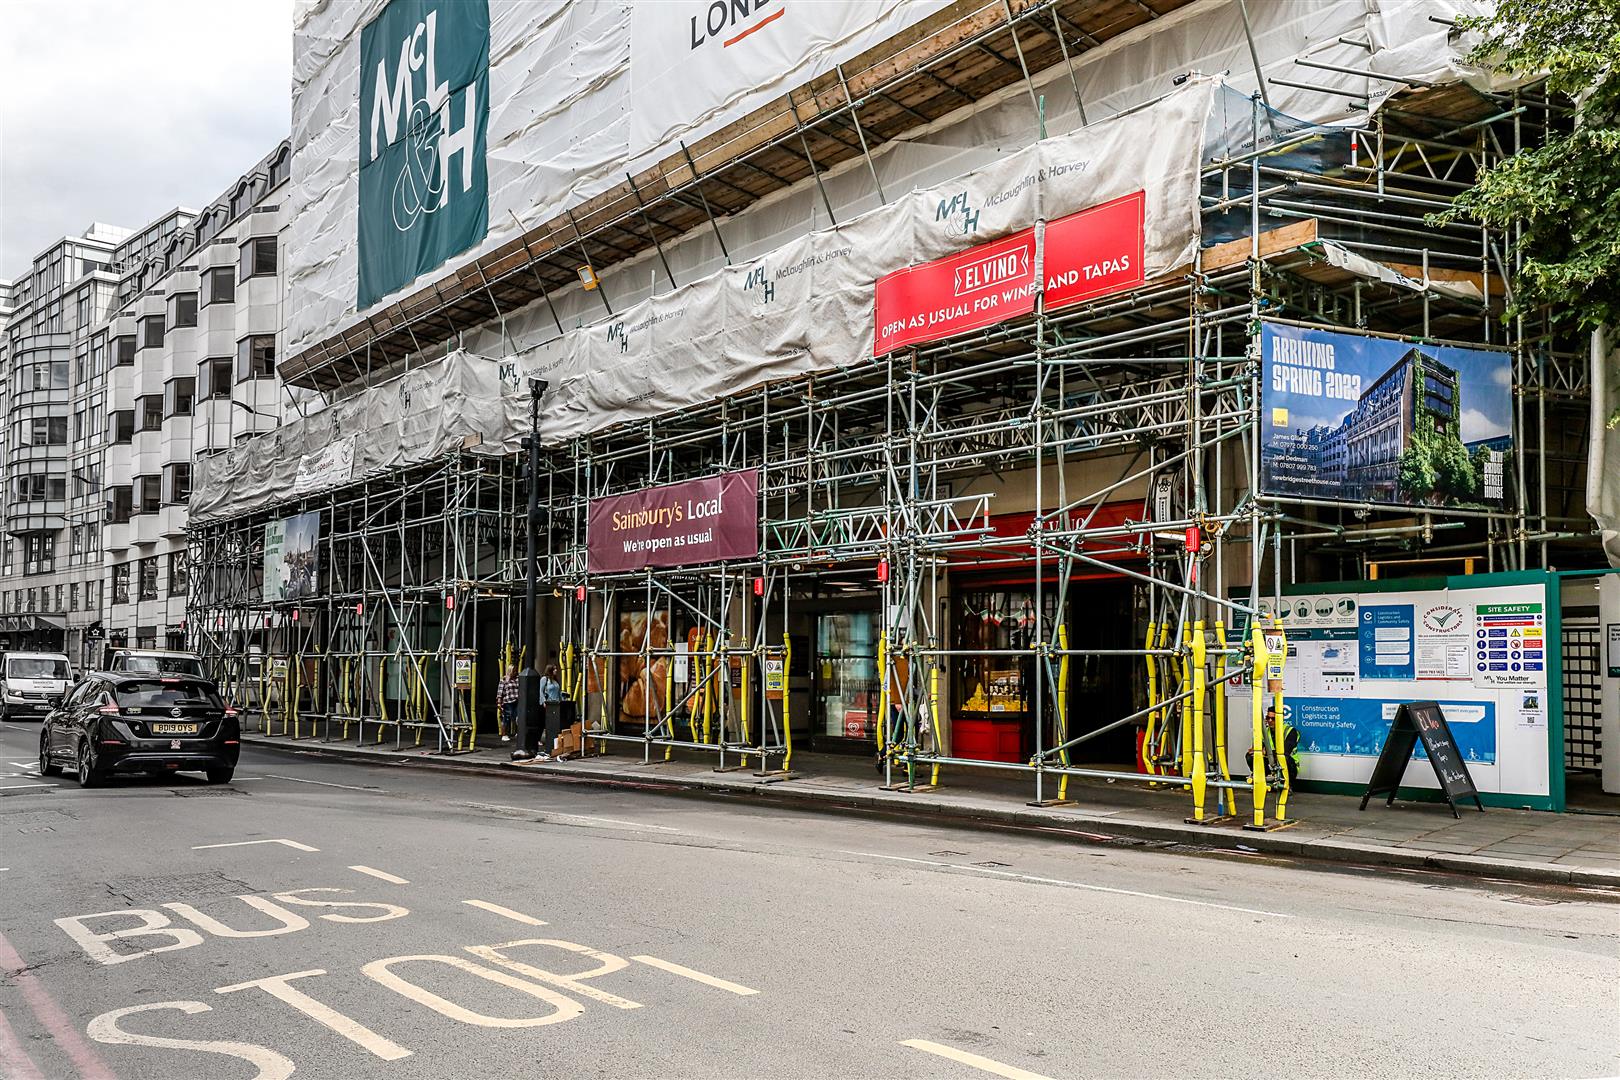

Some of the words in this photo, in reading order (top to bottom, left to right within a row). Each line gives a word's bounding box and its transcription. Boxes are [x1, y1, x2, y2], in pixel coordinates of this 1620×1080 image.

[983, 174, 1036, 208] McLaughlin
[1037, 168, 1047, 183] &
[1048, 160, 1090, 180] Harvey
[775, 257, 815, 281] McLaughlin
[825, 246, 853, 262] Harvey
[882, 318, 906, 339] OPEN
[908, 313, 926, 329] AS
[928, 306, 971, 326] USUAL
[973, 294, 999, 313] FOR
[1001, 282, 1036, 304] WINE
[1046, 269, 1079, 291] AND
[1082, 255, 1130, 281] TAPAS
[1272, 336, 1335, 370] ARRIVING
[1272, 364, 1322, 397] SPRING
[1325, 371, 1361, 401] 2023
[1484, 486, 1504, 499] HOUSE
[612, 501, 684, 531] Sainsbury's
[687, 492, 723, 520] Local
[623, 538, 645, 553] We're
[645, 535, 673, 552] open
[674, 534, 685, 547] as
[687, 528, 713, 544] usual
[1423, 605, 1463, 619] CONSIDERATE
[1487, 606, 1503, 614] SITE
[1503, 605, 1531, 613] SAFETY
[1423, 620, 1464, 634] CONSTRUCTORS
[1301, 704, 1340, 712] Construction
[1301, 720, 1336, 729] Community
[1336, 720, 1357, 730] Safety
[53, 887, 411, 966] BUS
[86, 938, 645, 1080] STOP
